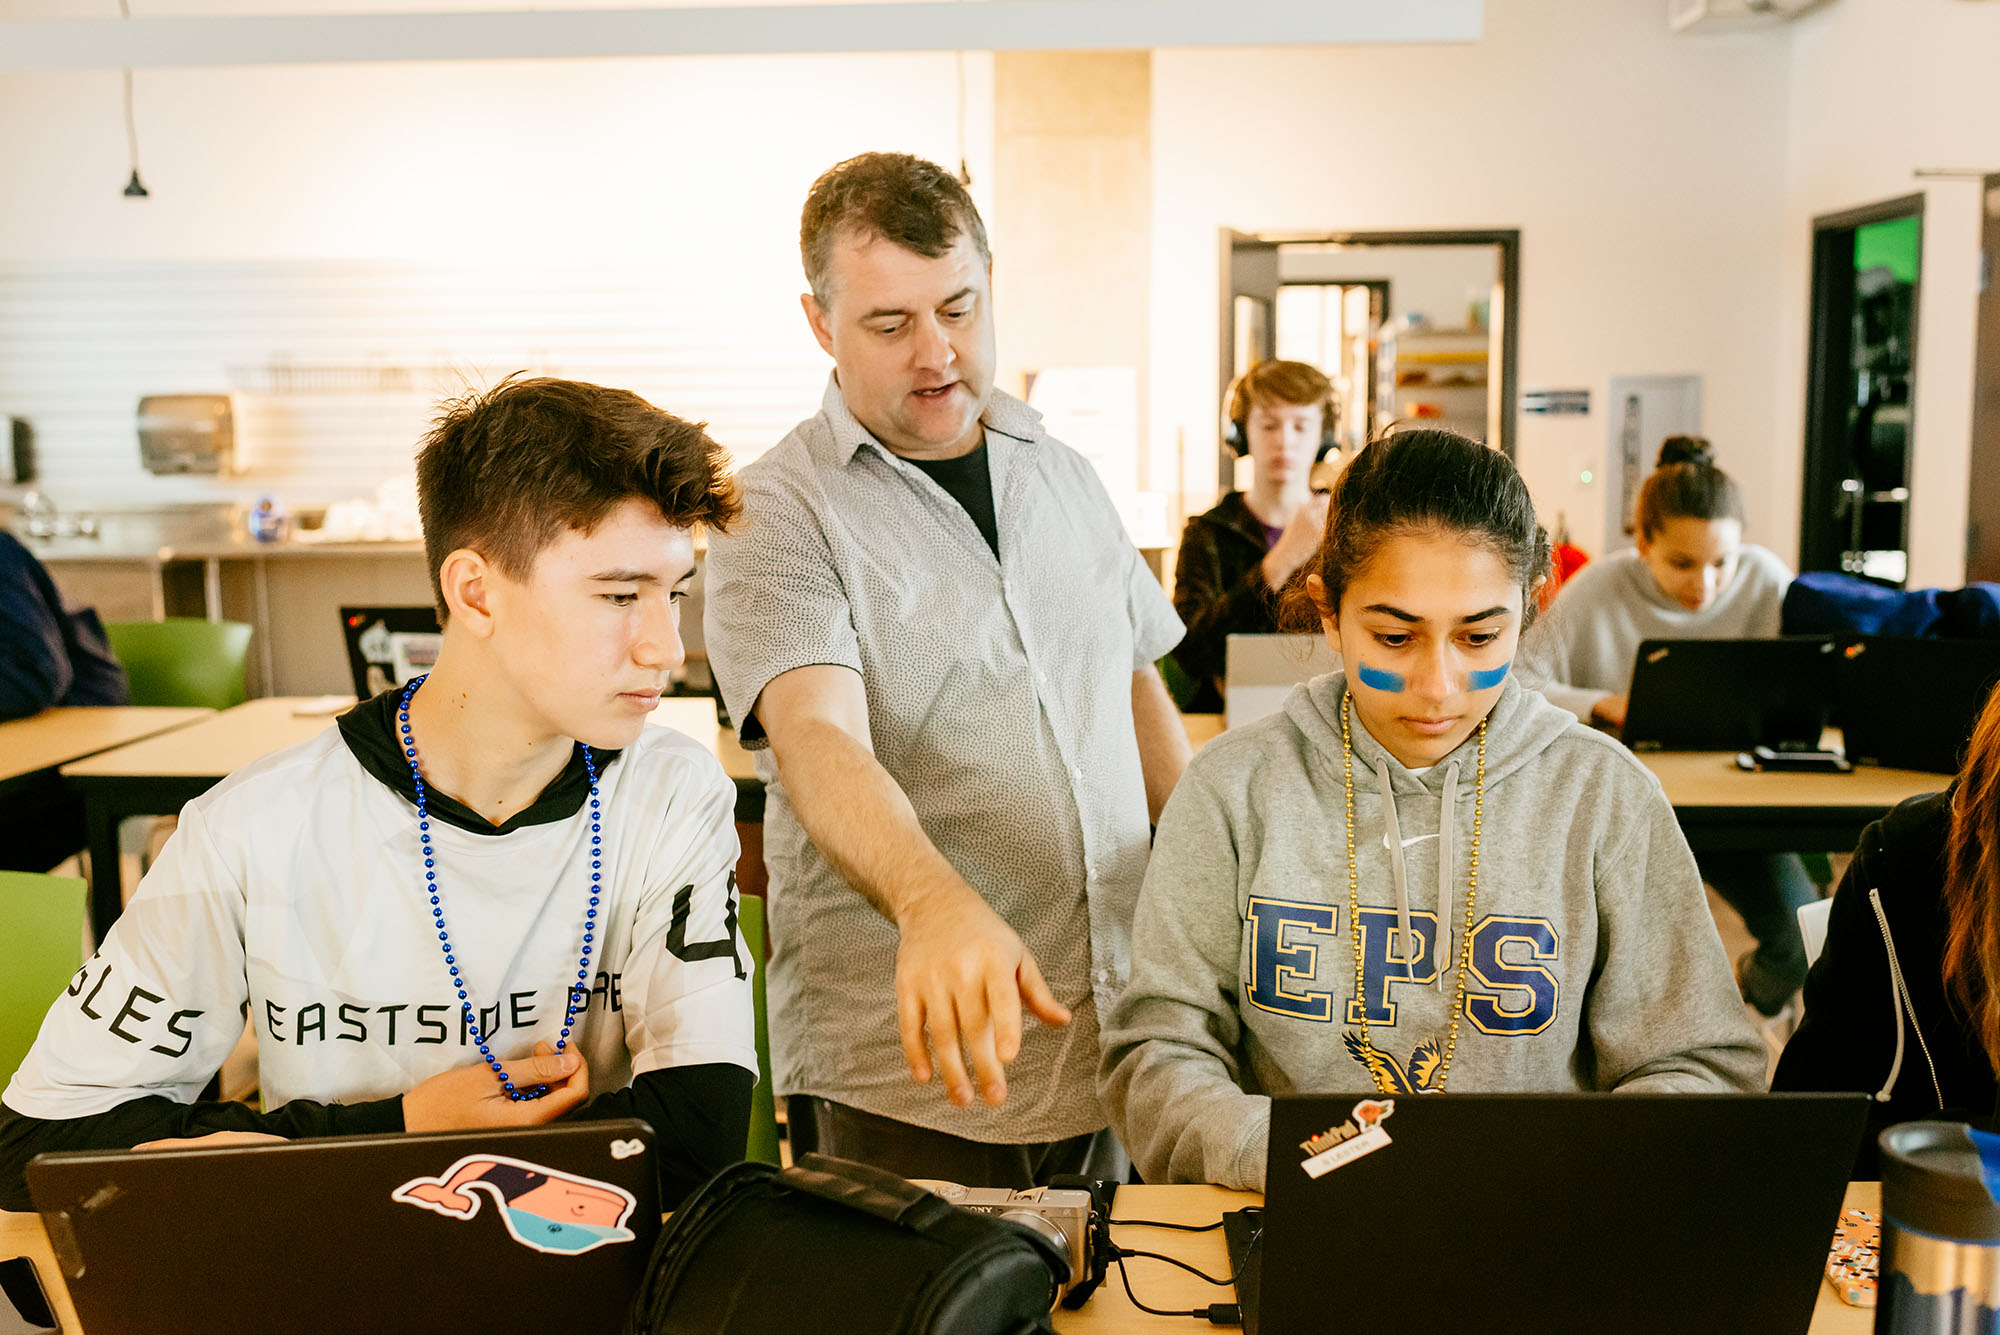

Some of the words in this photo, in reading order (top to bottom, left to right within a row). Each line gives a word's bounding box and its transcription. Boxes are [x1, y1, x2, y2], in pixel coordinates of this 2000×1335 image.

[1244, 894, 1559, 1036] EPS
[265, 990, 540, 1046] EASTSIDE
[964, 1206, 992, 1214] ONY
